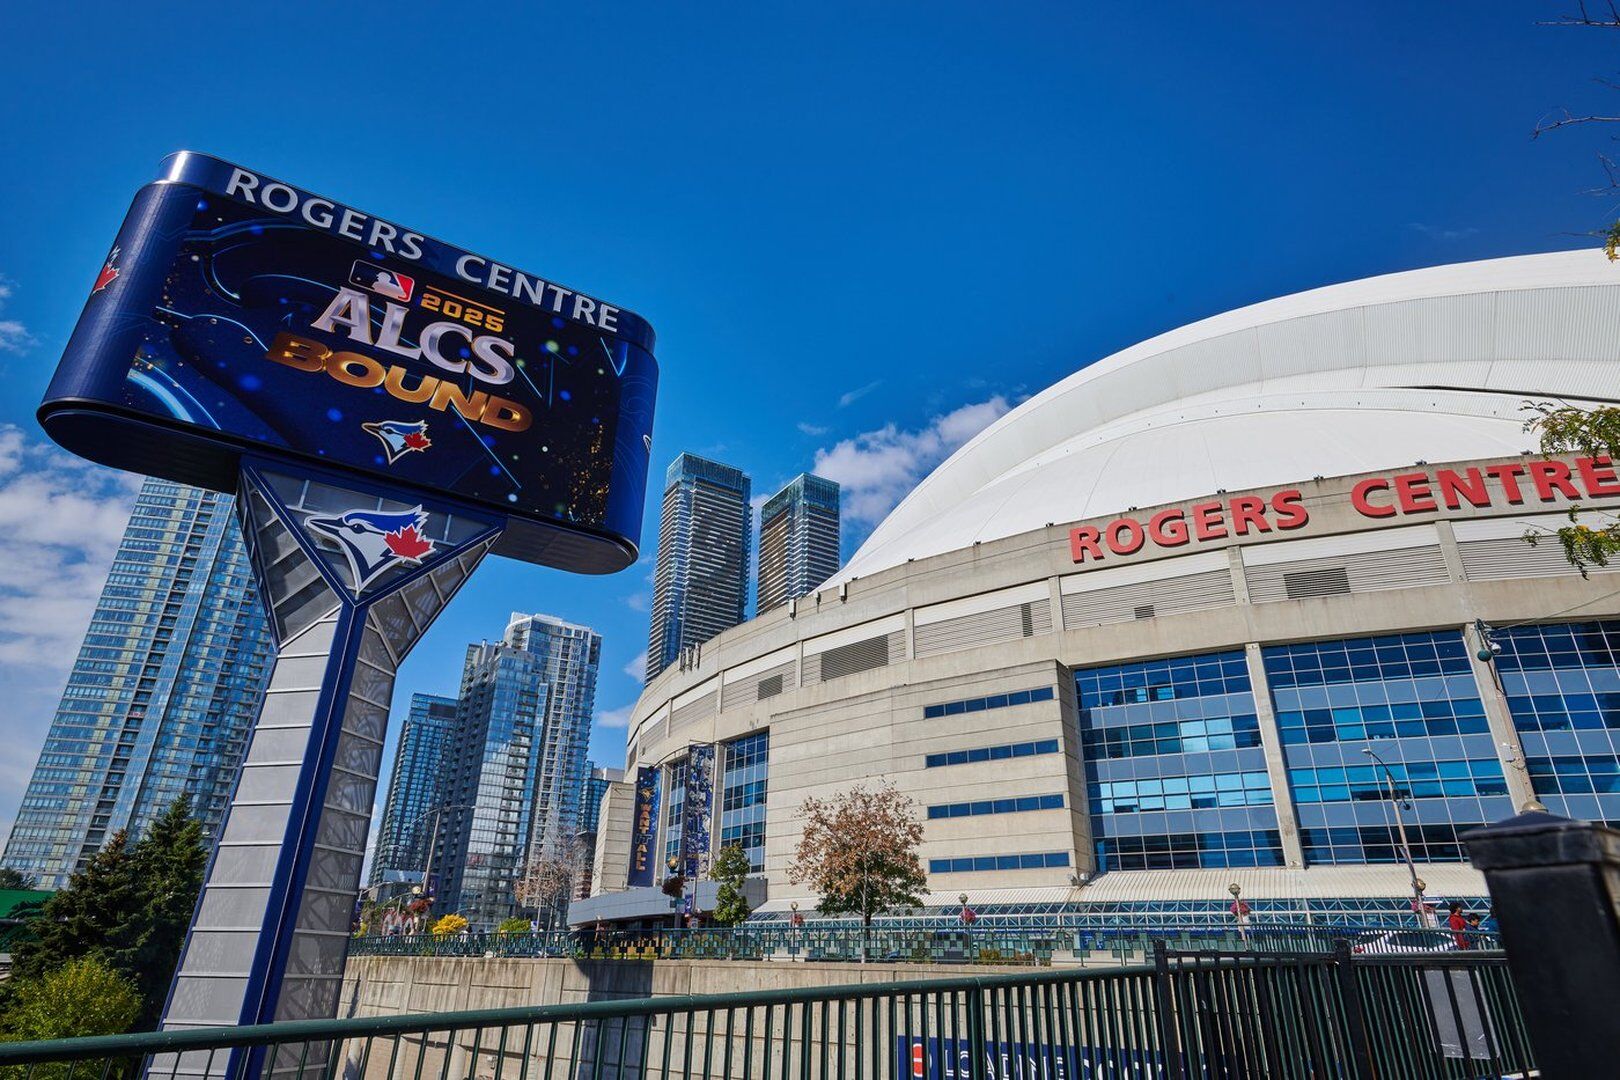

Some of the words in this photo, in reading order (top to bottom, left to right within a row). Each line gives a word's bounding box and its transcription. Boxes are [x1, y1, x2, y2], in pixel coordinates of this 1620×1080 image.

[225, 167, 424, 260] ROGERS
[455, 254, 620, 333] CENTRE
[310, 286, 516, 385] ALCS
[420, 293, 504, 333] 2025
[265, 331, 533, 432] BOUND
[1069, 490, 1309, 564] ROGERS
[1351, 455, 1620, 518] CENTRE
